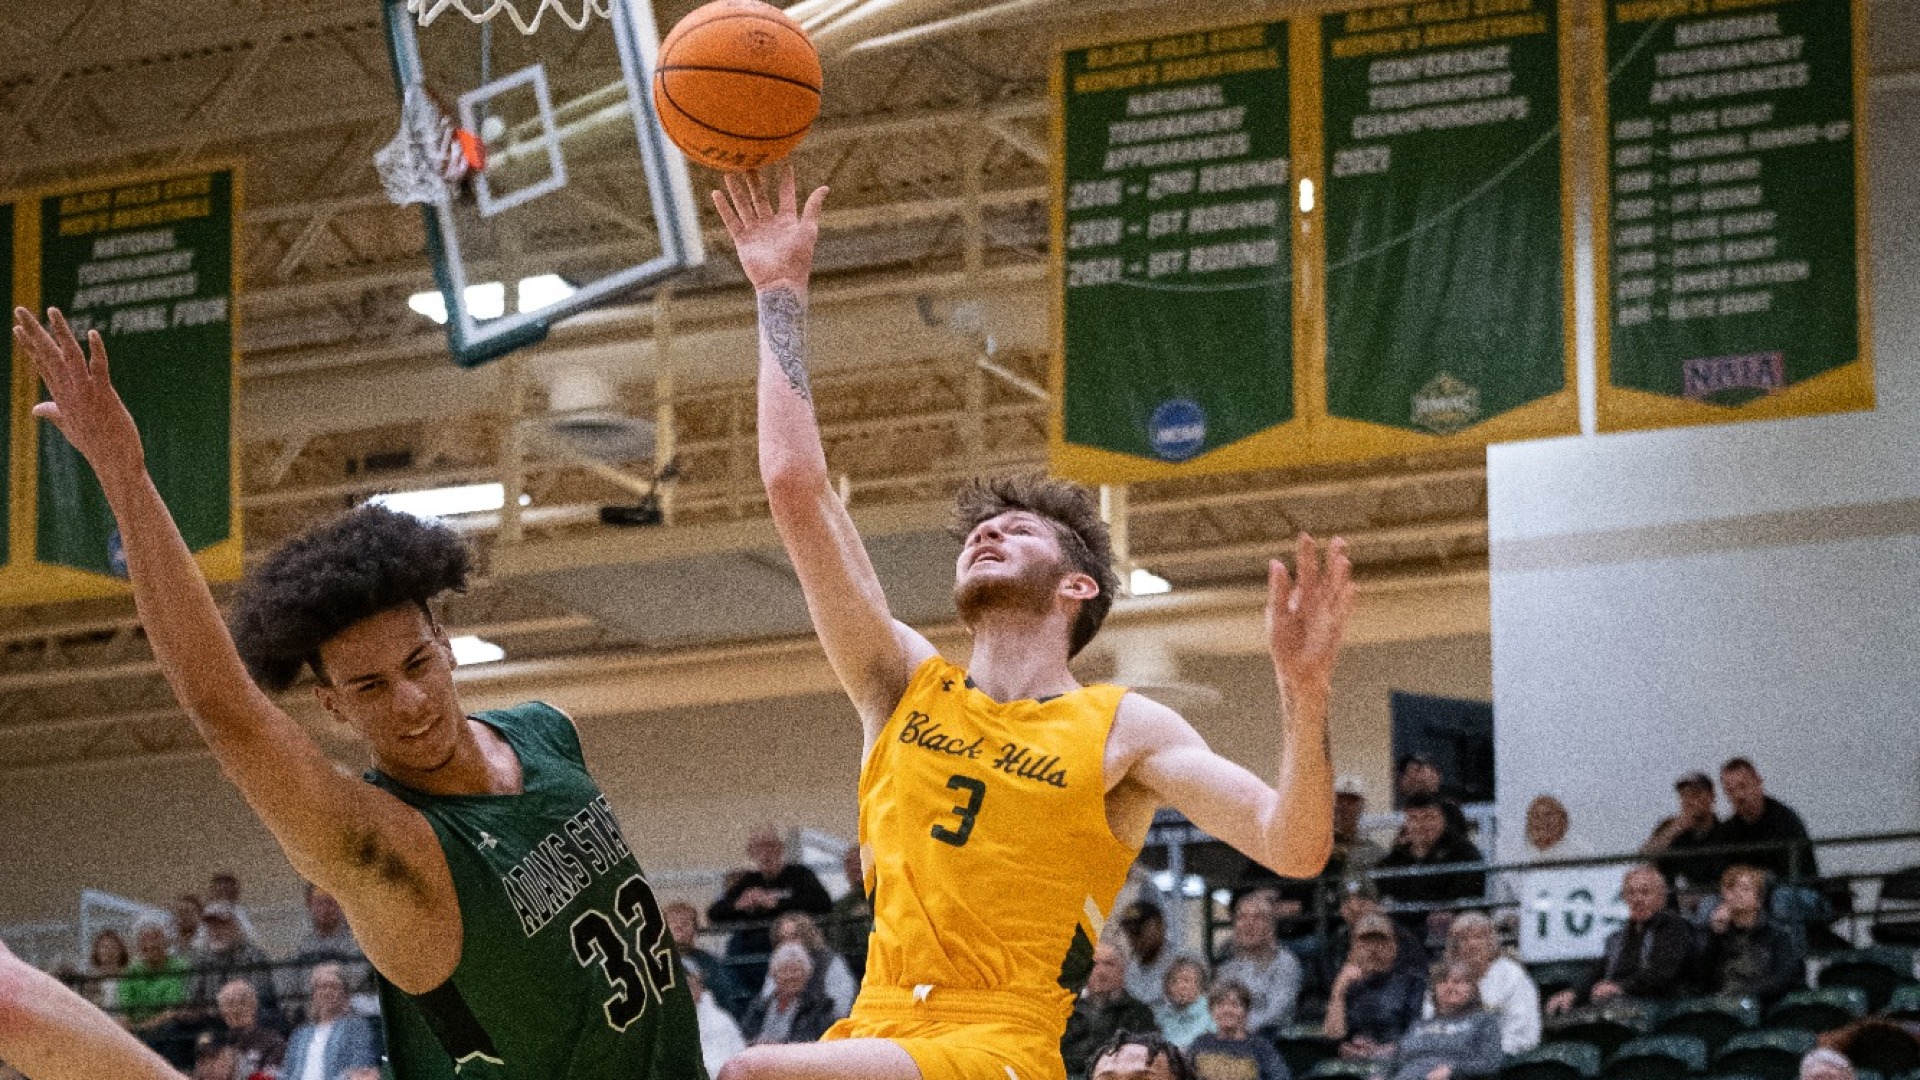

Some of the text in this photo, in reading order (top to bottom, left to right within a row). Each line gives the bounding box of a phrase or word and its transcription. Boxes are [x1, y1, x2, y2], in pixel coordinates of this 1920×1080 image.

[1674, 12, 1780, 46] NATIONAL
[1368, 45, 1511, 84] CONFERENCE
[1655, 35, 1804, 77] TOURNAMENT
[1126, 84, 1224, 116] NATIONAL
[1368, 71, 1515, 110] TOURNAMENT
[1651, 62, 1810, 105] APPEARANCES
[1108, 106, 1247, 145] TOURNAMENT
[1353, 95, 1531, 139] CHAMPIONSHIPS
[1103, 132, 1249, 172] APPEARANCES
[1199, 157, 1289, 194] ROUND
[1188, 200, 1279, 234] ROUND
[93, 228, 175, 259] NATIONAL
[1188, 239, 1280, 273] ROUND
[78, 250, 194, 285] TOURNAMENT
[71, 272, 198, 311] APPEARANCES
[110, 305, 167, 336] FINAL
[172, 298, 228, 329] FOUR
[899, 711, 1068, 788] Black Hills
[930, 774, 987, 847] 3
[502, 834, 592, 938] ADAMS
[570, 874, 676, 1032] 32
